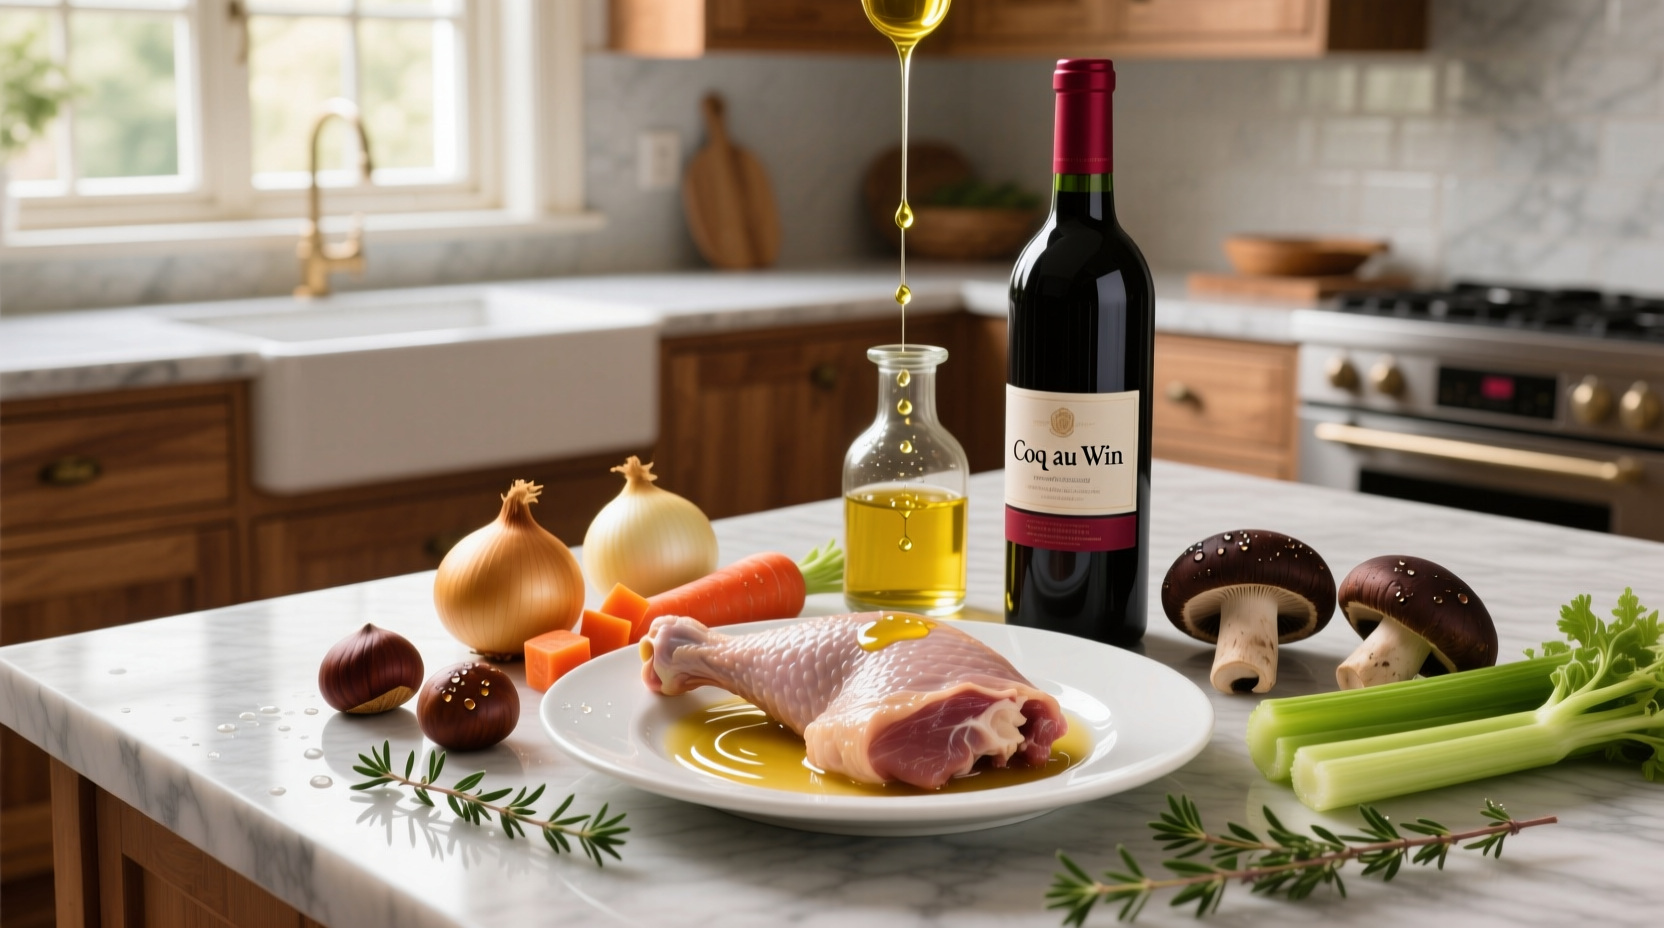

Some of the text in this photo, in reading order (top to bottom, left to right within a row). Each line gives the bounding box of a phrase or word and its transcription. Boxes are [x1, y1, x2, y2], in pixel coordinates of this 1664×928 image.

[1013, 439, 1123, 471] Coq au Win
